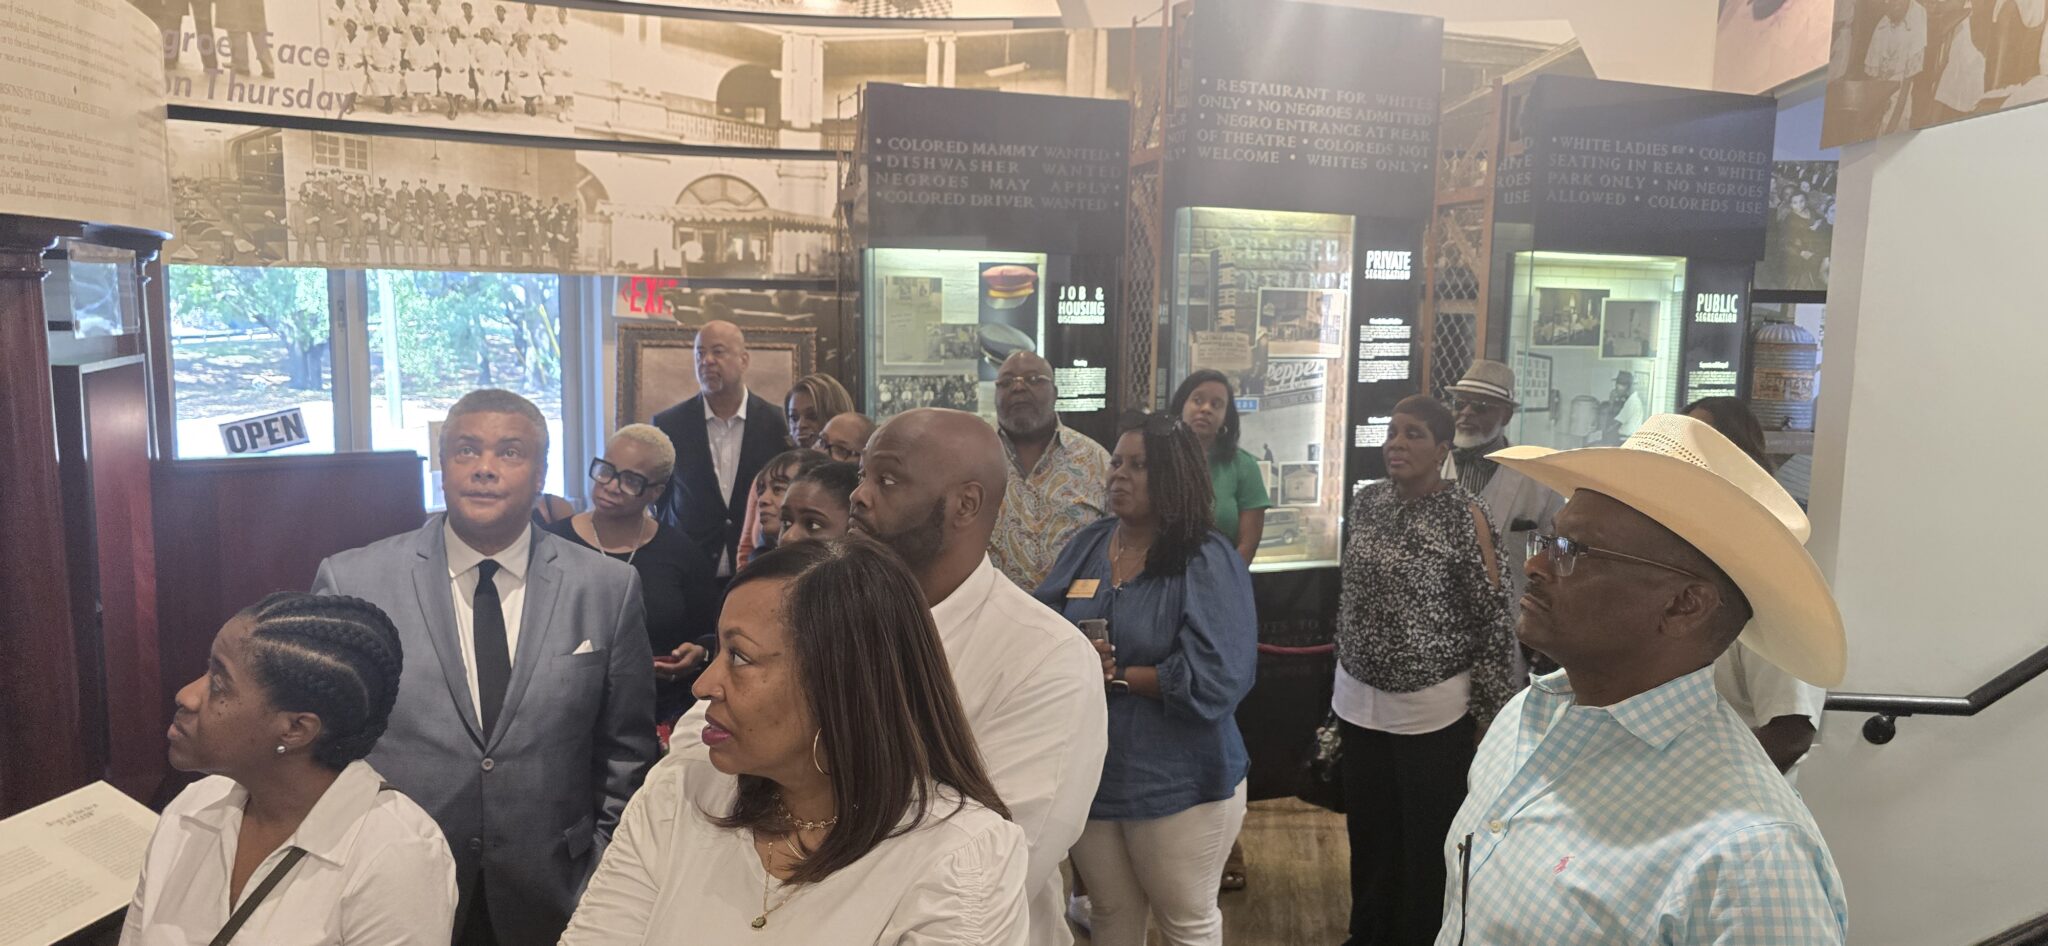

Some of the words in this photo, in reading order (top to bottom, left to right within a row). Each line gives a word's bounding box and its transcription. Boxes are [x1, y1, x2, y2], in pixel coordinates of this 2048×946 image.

[258, 31, 331, 68] Face
[203, 68, 355, 120] Thursday
[1217, 79, 1329, 101] RESTAURANT
[1337, 90, 1367, 104] FOR
[1376, 94, 1433, 110] WHITES
[1198, 94, 1241, 110] ONLY
[1258, 99, 1281, 113] NO
[1285, 102, 1352, 120] NEGROES
[1355, 108, 1431, 126] ADMITTED
[1217, 113, 1271, 129] NEGRO
[1276, 118, 1361, 137] ENTRANCE
[1365, 126, 1387, 139] AT
[1391, 128, 1431, 142] REAR
[888, 137, 968, 154] COLORED
[972, 141, 1039, 158] MAMMY
[1044, 145, 1110, 161] WANTED
[1197, 129, 1218, 142] OF
[1222, 130, 1296, 148] THEATRE
[1315, 138, 1393, 155] COLOREDS
[1398, 144, 1429, 158] NOT
[1560, 136, 1611, 152] WHITE
[1615, 140, 1668, 156] LADIES
[1700, 147, 1766, 164] COLORED
[887, 154, 1019, 174] DISHWASHER
[1042, 162, 1120, 178] WANTED
[1198, 145, 1279, 163] WELCOME
[1307, 154, 1367, 169] WHITES
[1376, 159, 1420, 173] ONLY
[1549, 153, 1620, 171] SEATING
[1628, 159, 1646, 172] IN
[1654, 161, 1695, 176] REAR
[1718, 166, 1765, 181] WHITE
[876, 172, 969, 188] NEGROES
[990, 178, 1031, 192] MAY
[1050, 180, 1110, 194] APPLY
[1548, 170, 1593, 186] PARK
[1600, 174, 1646, 190] ONLY
[1667, 179, 1689, 192] NO
[1696, 181, 1763, 198] NEGROES
[884, 190, 965, 206] COLORED
[970, 194, 1035, 208] DRIVER
[1041, 196, 1107, 211] WANTED
[1545, 189, 1626, 206] ALLOWED
[1648, 195, 1729, 212] COLOREDS
[1736, 201, 1763, 214] USE
[1366, 250, 1411, 270] PRIVATE
[1059, 285, 1087, 301] JOB
[1095, 287, 1104, 301] &
[1696, 293, 1739, 313] PUBLIC
[1058, 300, 1105, 316] HOUSING
[1695, 312, 1737, 324] SEGREGATION
[225, 412, 305, 453] OPEN
